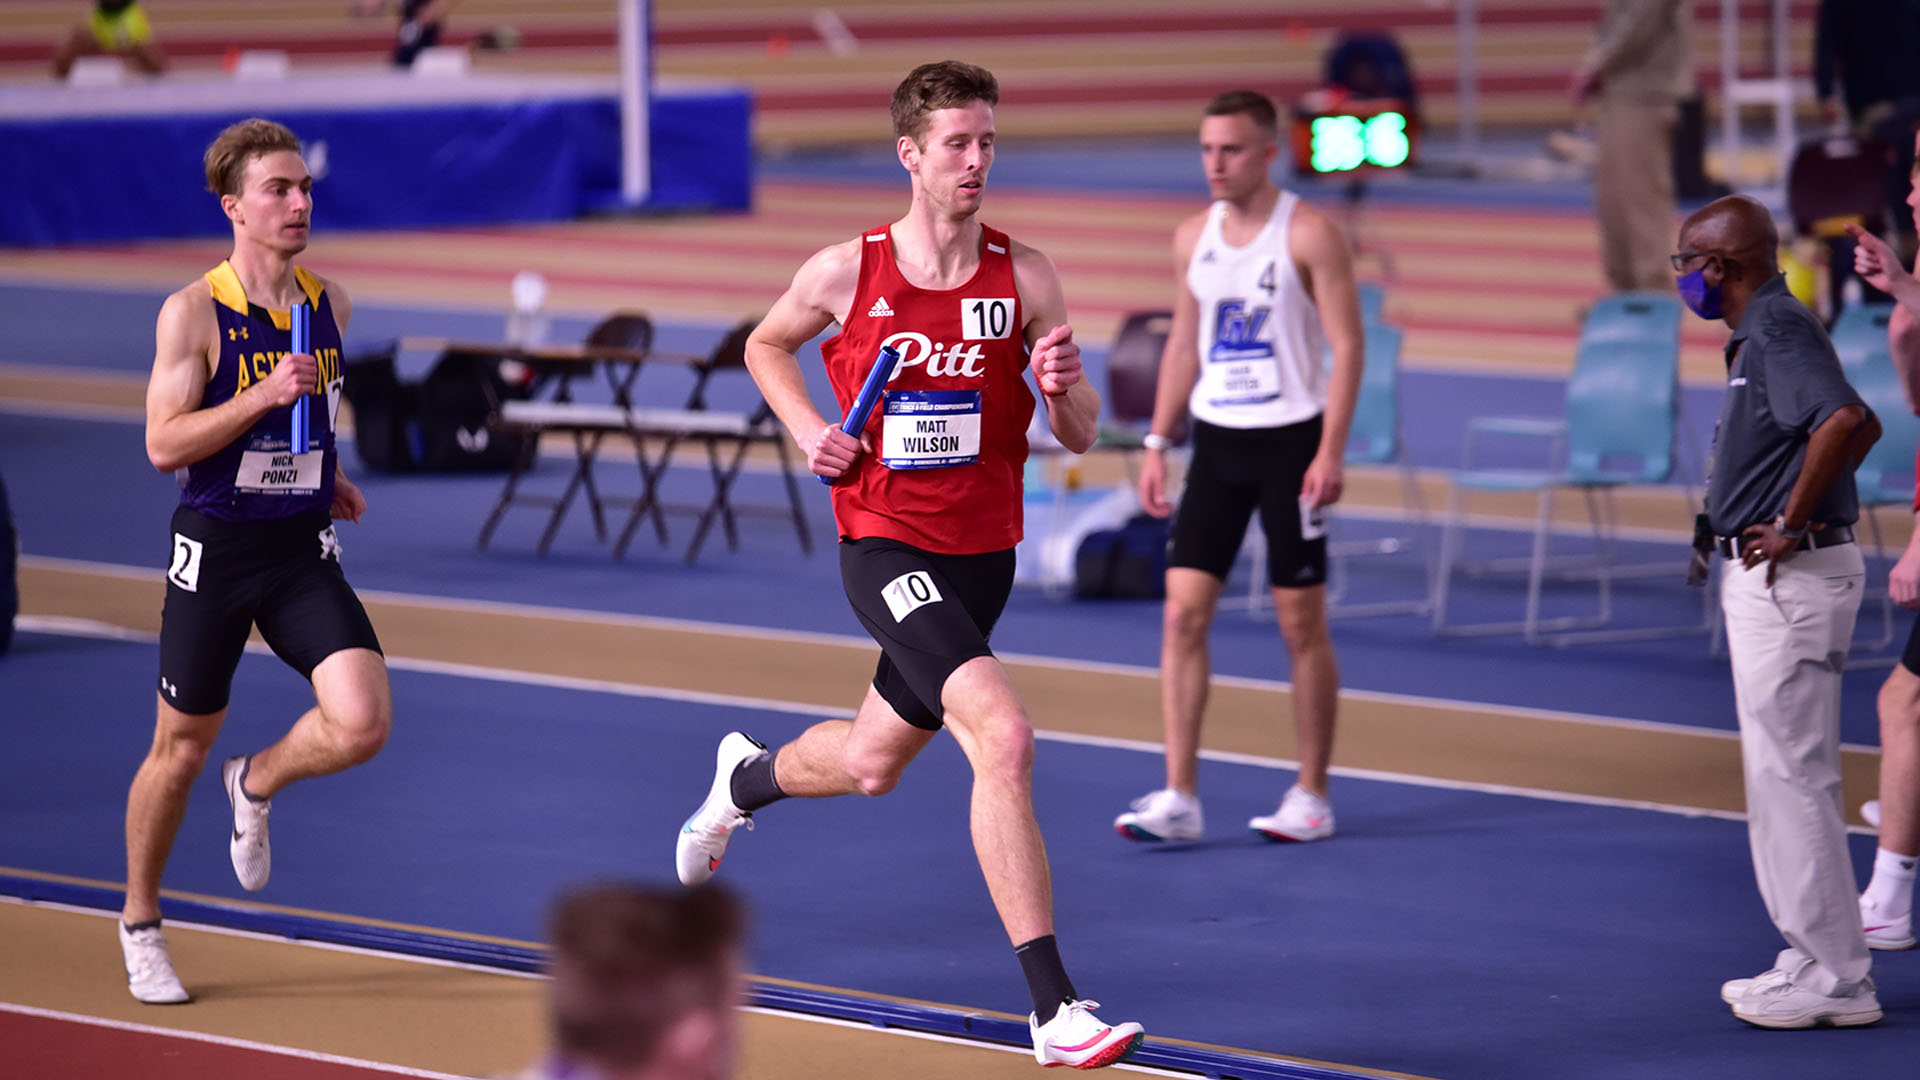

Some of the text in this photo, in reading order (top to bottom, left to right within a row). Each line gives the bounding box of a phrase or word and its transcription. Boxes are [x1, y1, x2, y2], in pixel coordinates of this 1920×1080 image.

[1258, 260, 1276, 297] 4
[868, 309, 895, 318] adidas
[972, 300, 1007, 338] 10
[880, 331, 986, 383] Pitt
[916, 420, 947, 433] MATT
[903, 435, 959, 453] WILSON
[271, 455, 294, 468] NICK
[261, 469, 298, 484] PONZI
[174, 541, 193, 586] 2
[892, 574, 931, 609] 10
